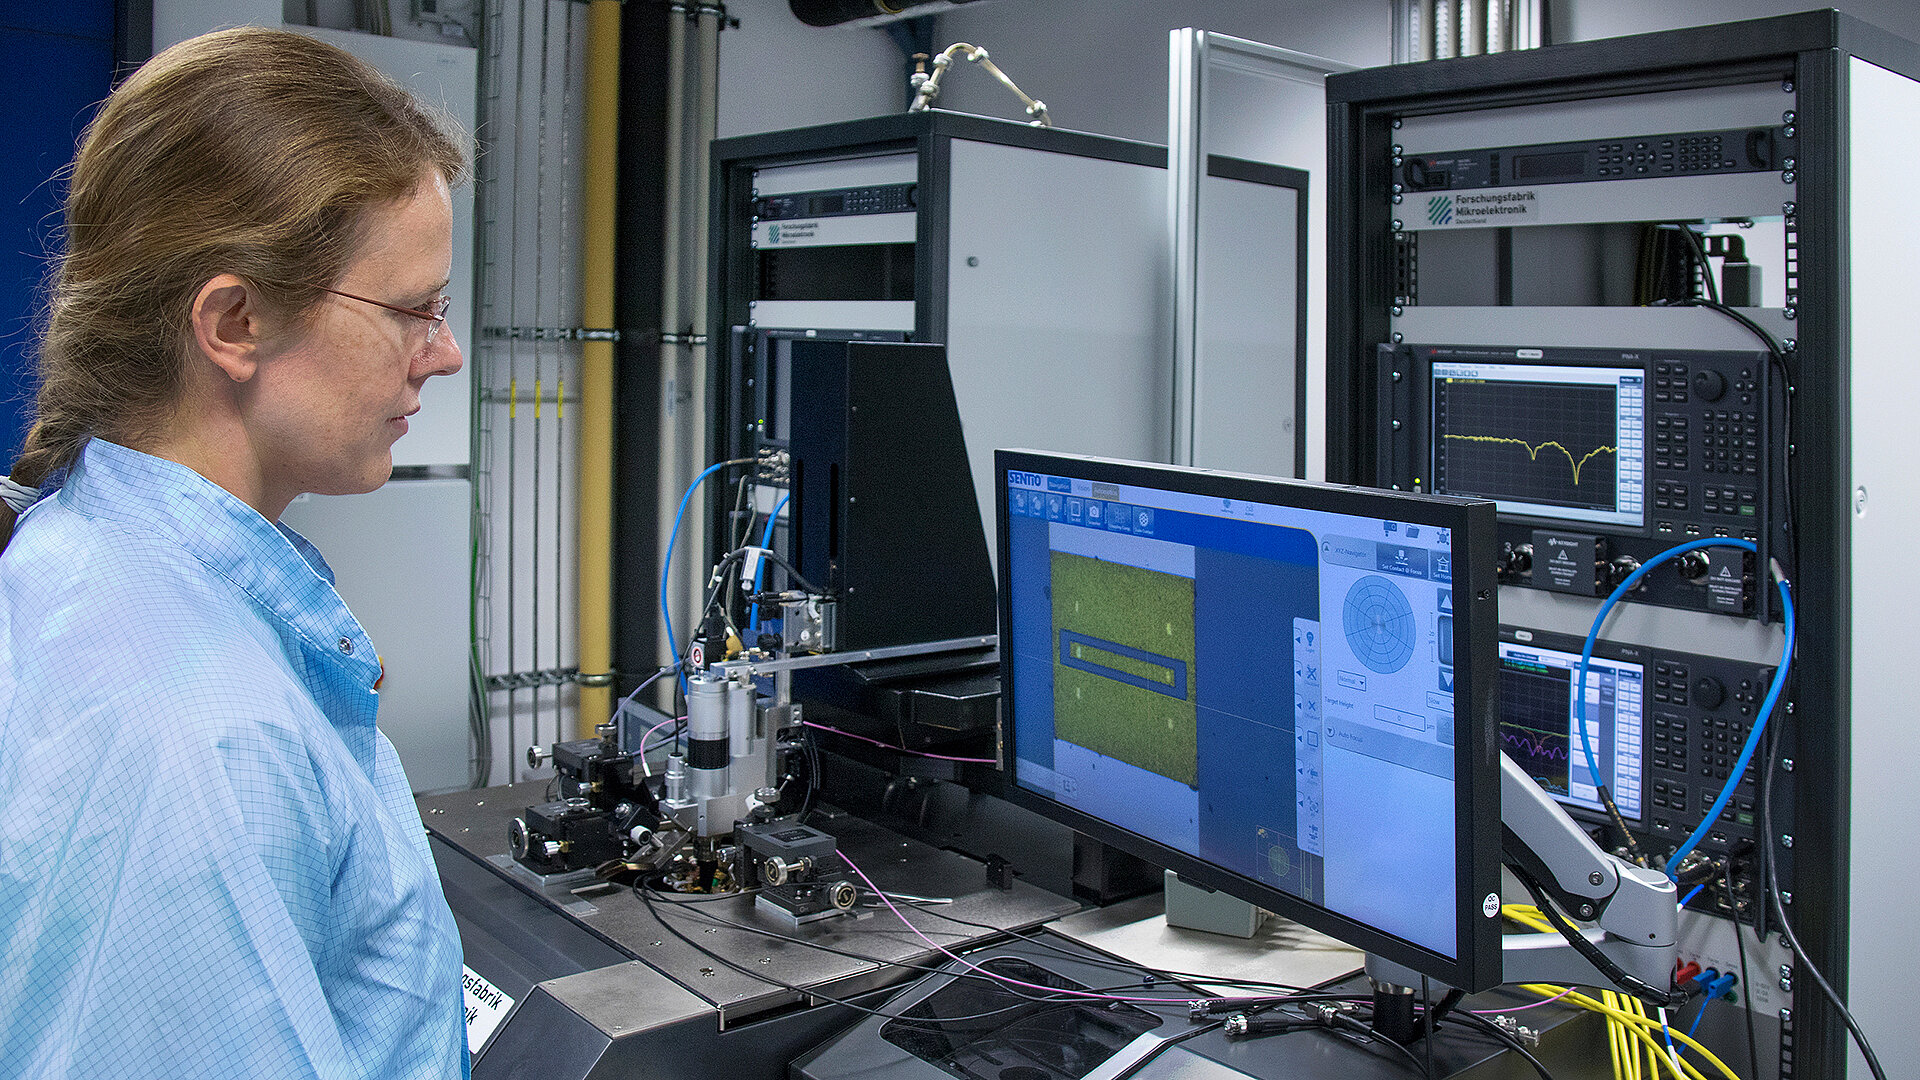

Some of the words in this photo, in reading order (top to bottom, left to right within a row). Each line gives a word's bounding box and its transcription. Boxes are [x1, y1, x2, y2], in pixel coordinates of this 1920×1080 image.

[1455, 191, 1536, 204] Forschungsfabrik
[1456, 204, 1528, 216] Mikroelektronik
[1485, 903, 1498, 911] PASS
